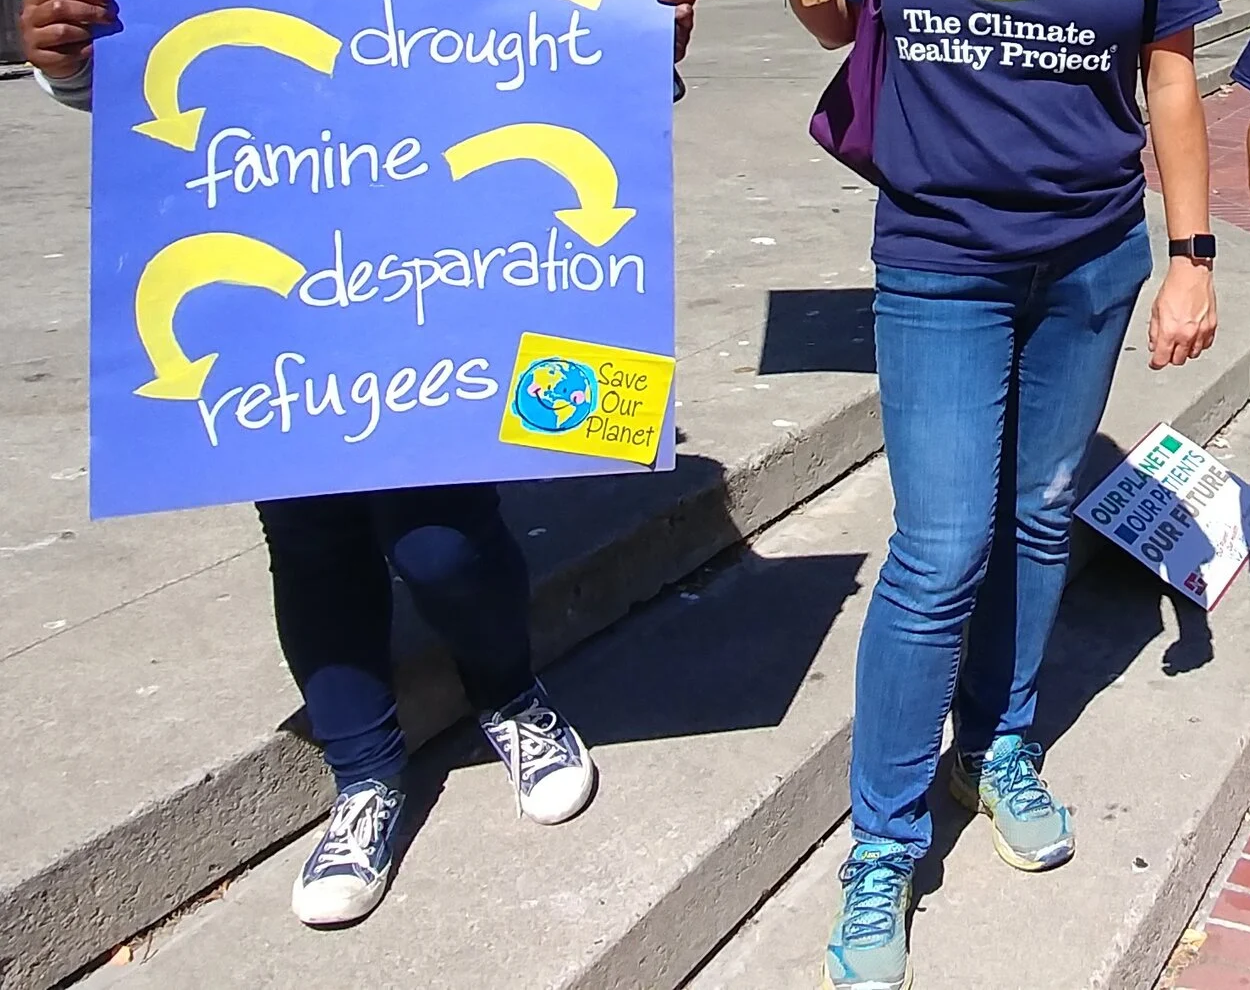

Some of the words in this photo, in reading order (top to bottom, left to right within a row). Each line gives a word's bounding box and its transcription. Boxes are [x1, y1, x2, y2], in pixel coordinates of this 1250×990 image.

[895, 36, 997, 71] Reality
[903, 8, 961, 35] The
[968, 12, 1097, 46] Climate
[185, 127, 430, 210] famine
[297, 226, 646, 327] desparation
[197, 351, 500, 447] refugees
[597, 362, 648, 391] Save
[601, 390, 643, 417] Our
[586, 415, 655, 448] Planet
[1090, 491, 1127, 526] OUR
[1118, 446, 1171, 498] PLANET
[1126, 499, 1164, 533] OUR
[1150, 449, 1206, 507] PATIENTS
[1140, 521, 1185, 563] OUR
[1169, 465, 1231, 529] FUTURE
